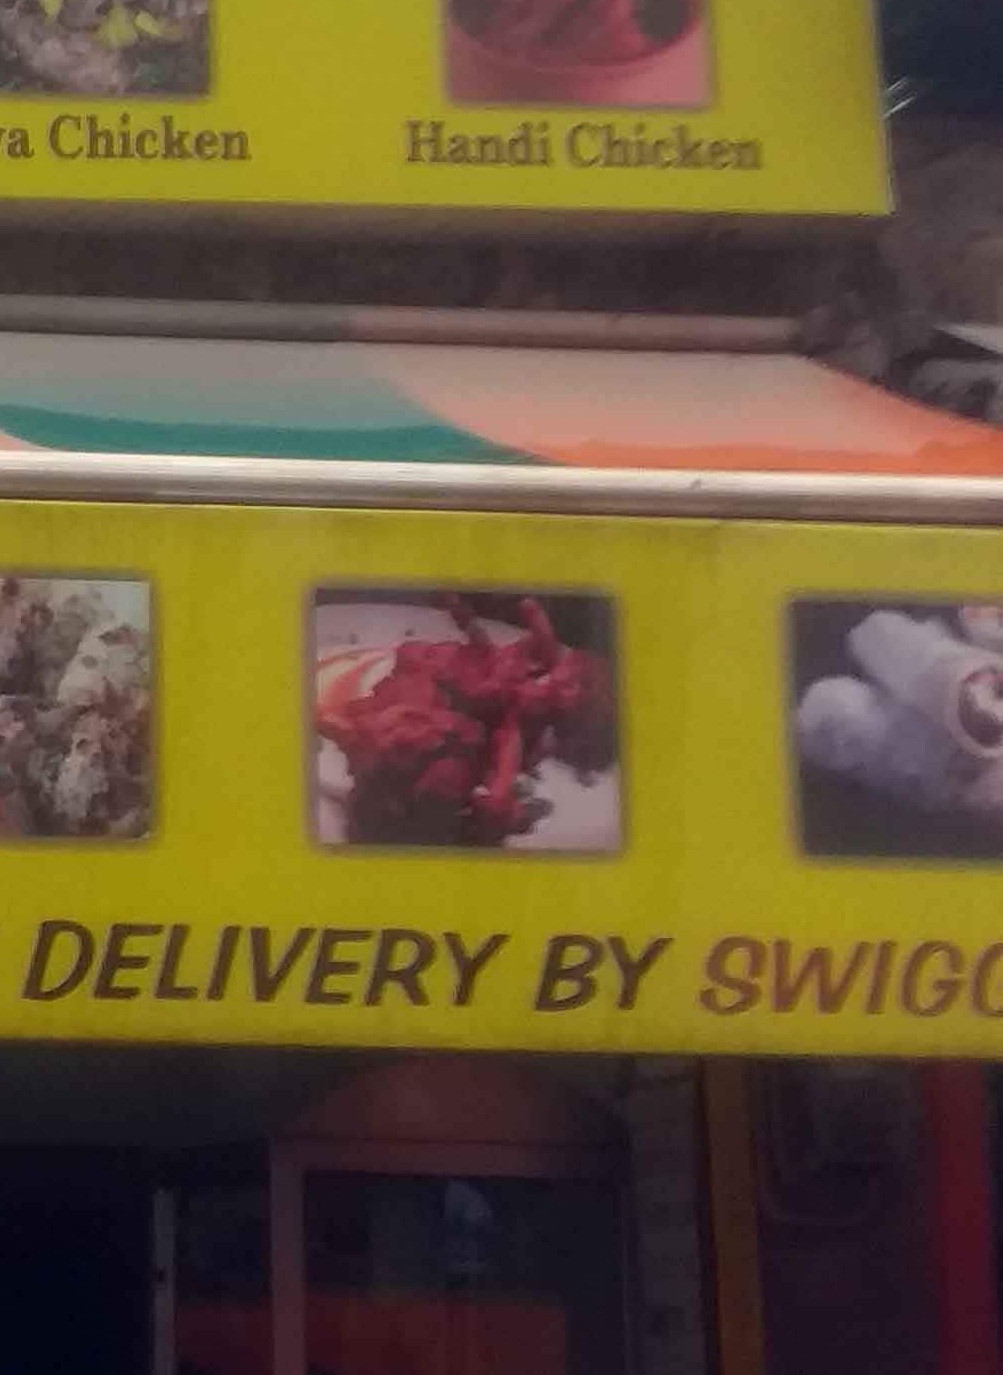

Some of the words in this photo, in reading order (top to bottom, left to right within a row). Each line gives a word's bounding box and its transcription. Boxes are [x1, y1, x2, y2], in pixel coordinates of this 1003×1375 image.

[48, 113, 252, 161] Chicken
[405, 120, 552, 167] Handi
[566, 122, 762, 170] Chicken
[21, 919, 510, 1007] DELIVERY
[533, 932, 673, 1012] BY
